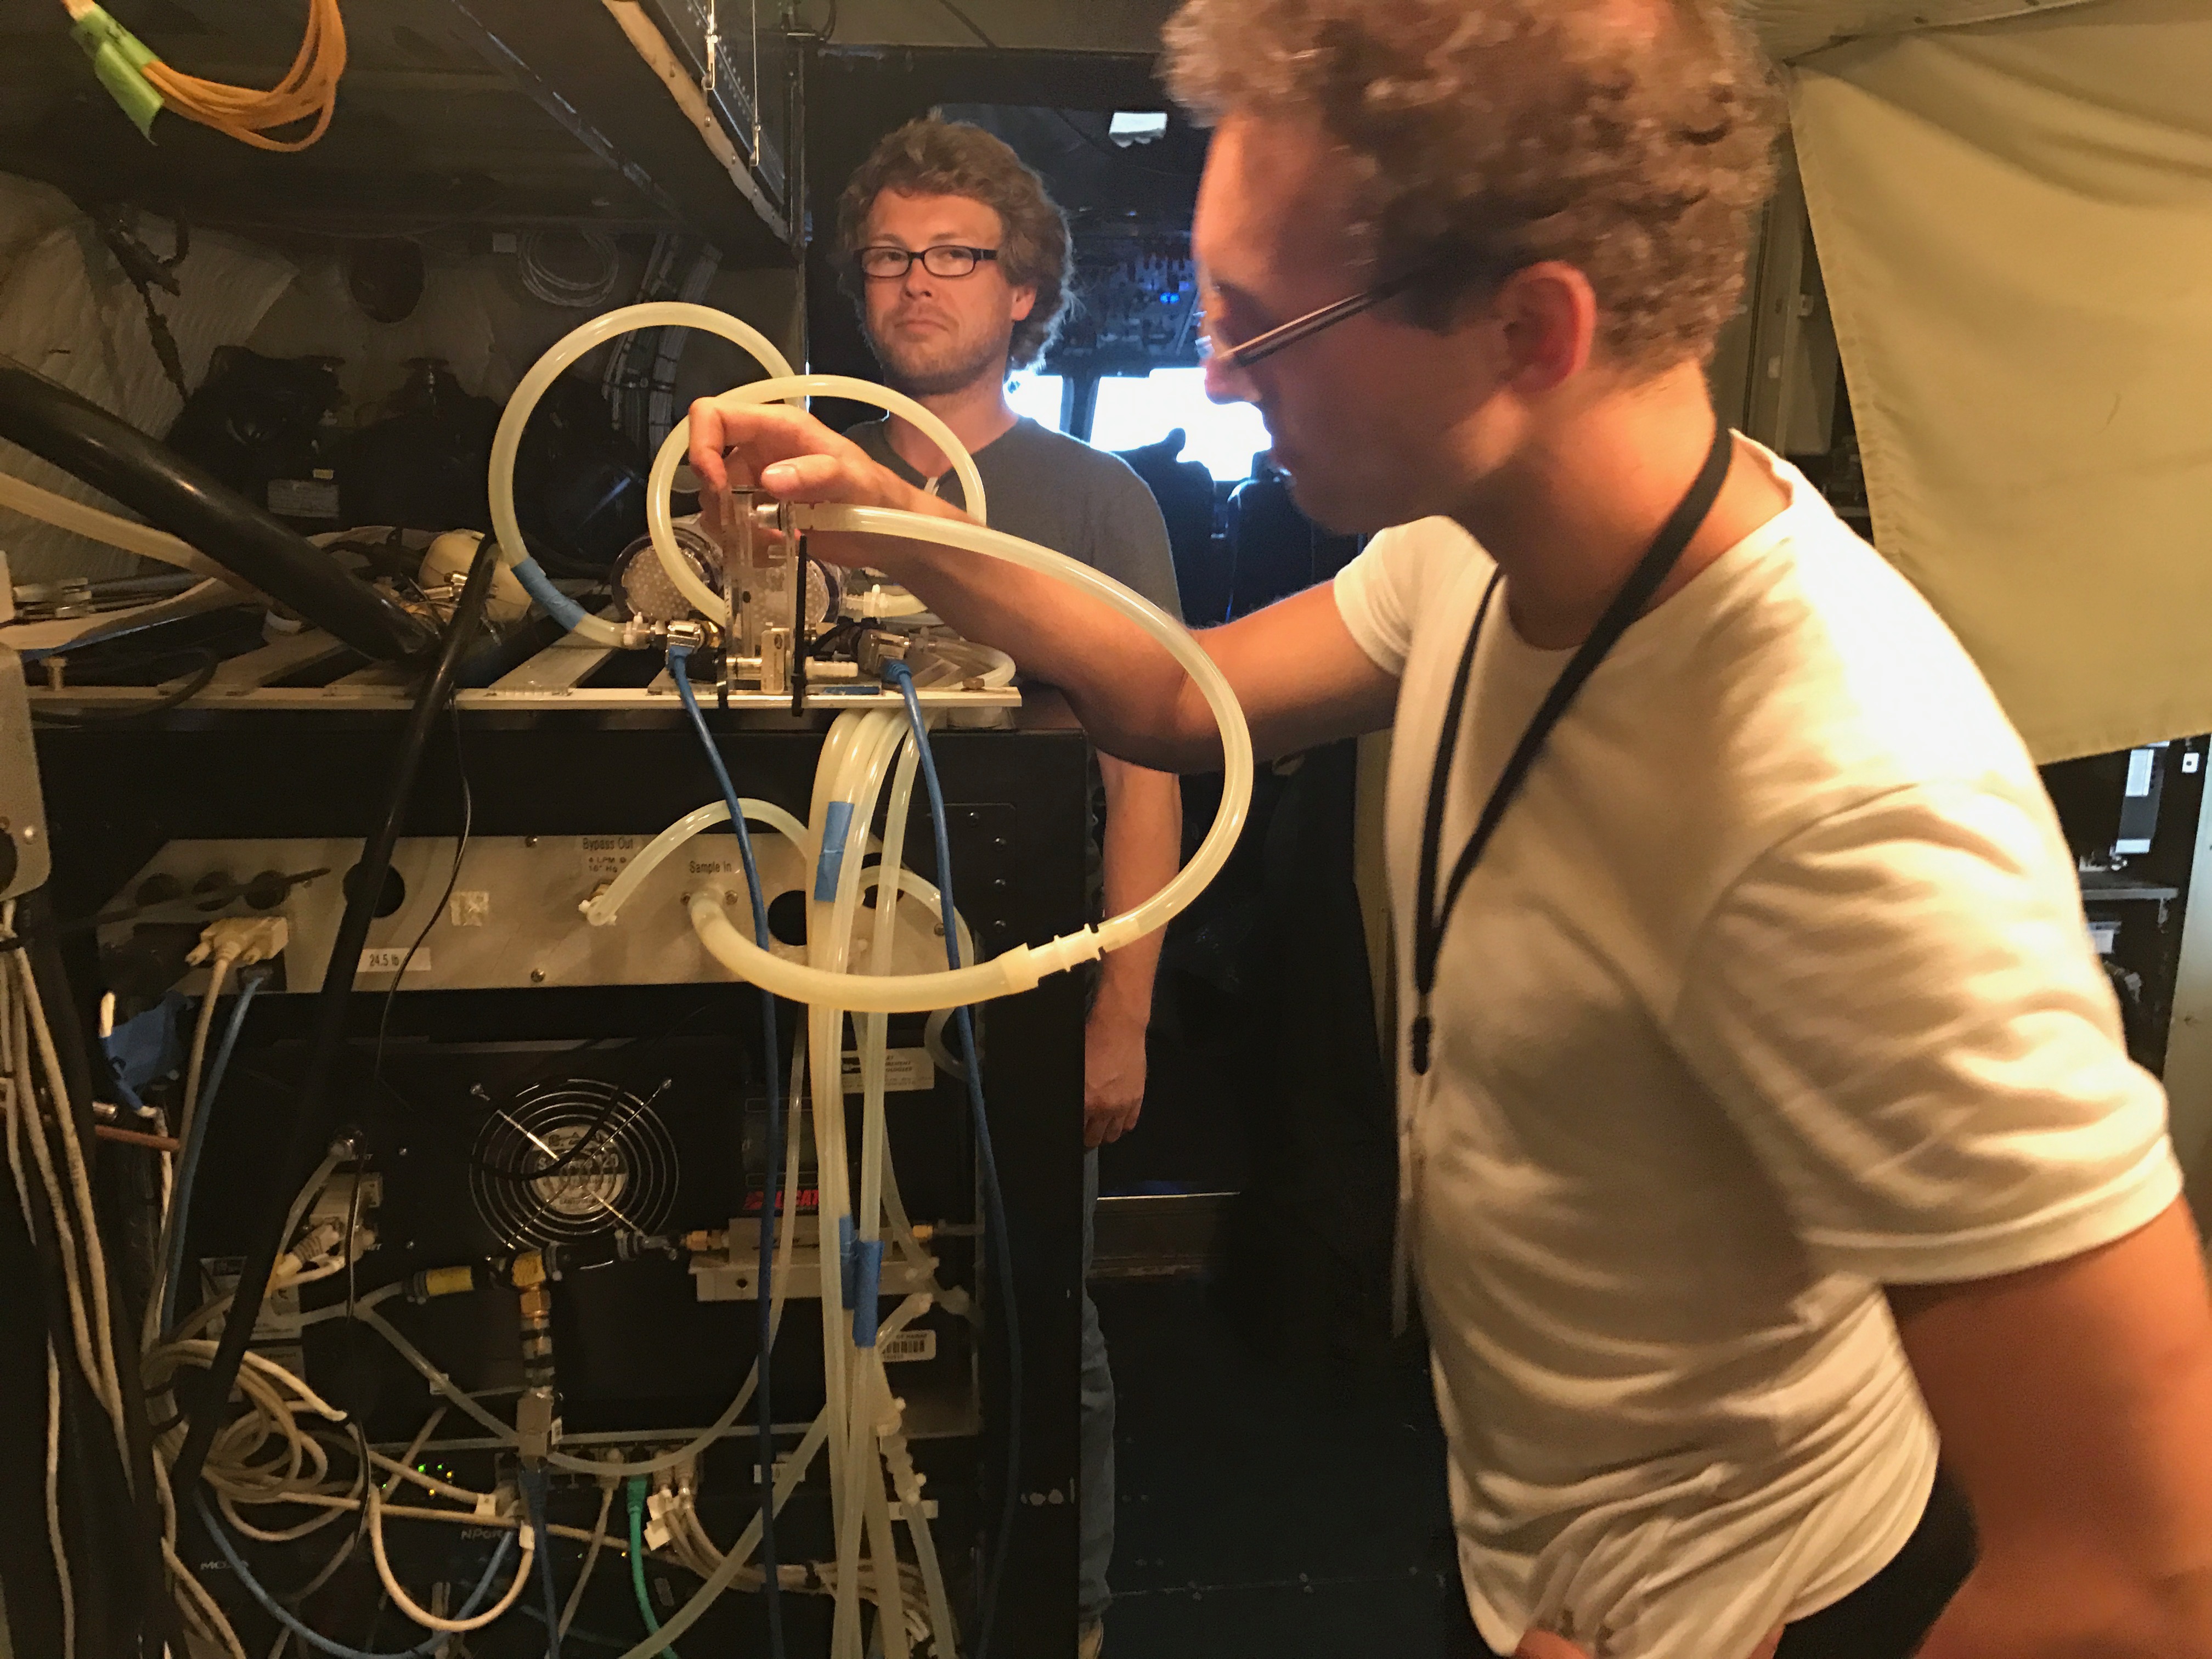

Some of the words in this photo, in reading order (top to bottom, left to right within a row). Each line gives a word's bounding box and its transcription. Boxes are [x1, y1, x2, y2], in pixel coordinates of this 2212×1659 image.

[583, 837, 614, 851] Bypass
[618, 837, 633, 849] Out
[690, 860, 720, 874] Sample
[724, 861, 732, 872] In
[370, 953, 388, 966] 24.5
